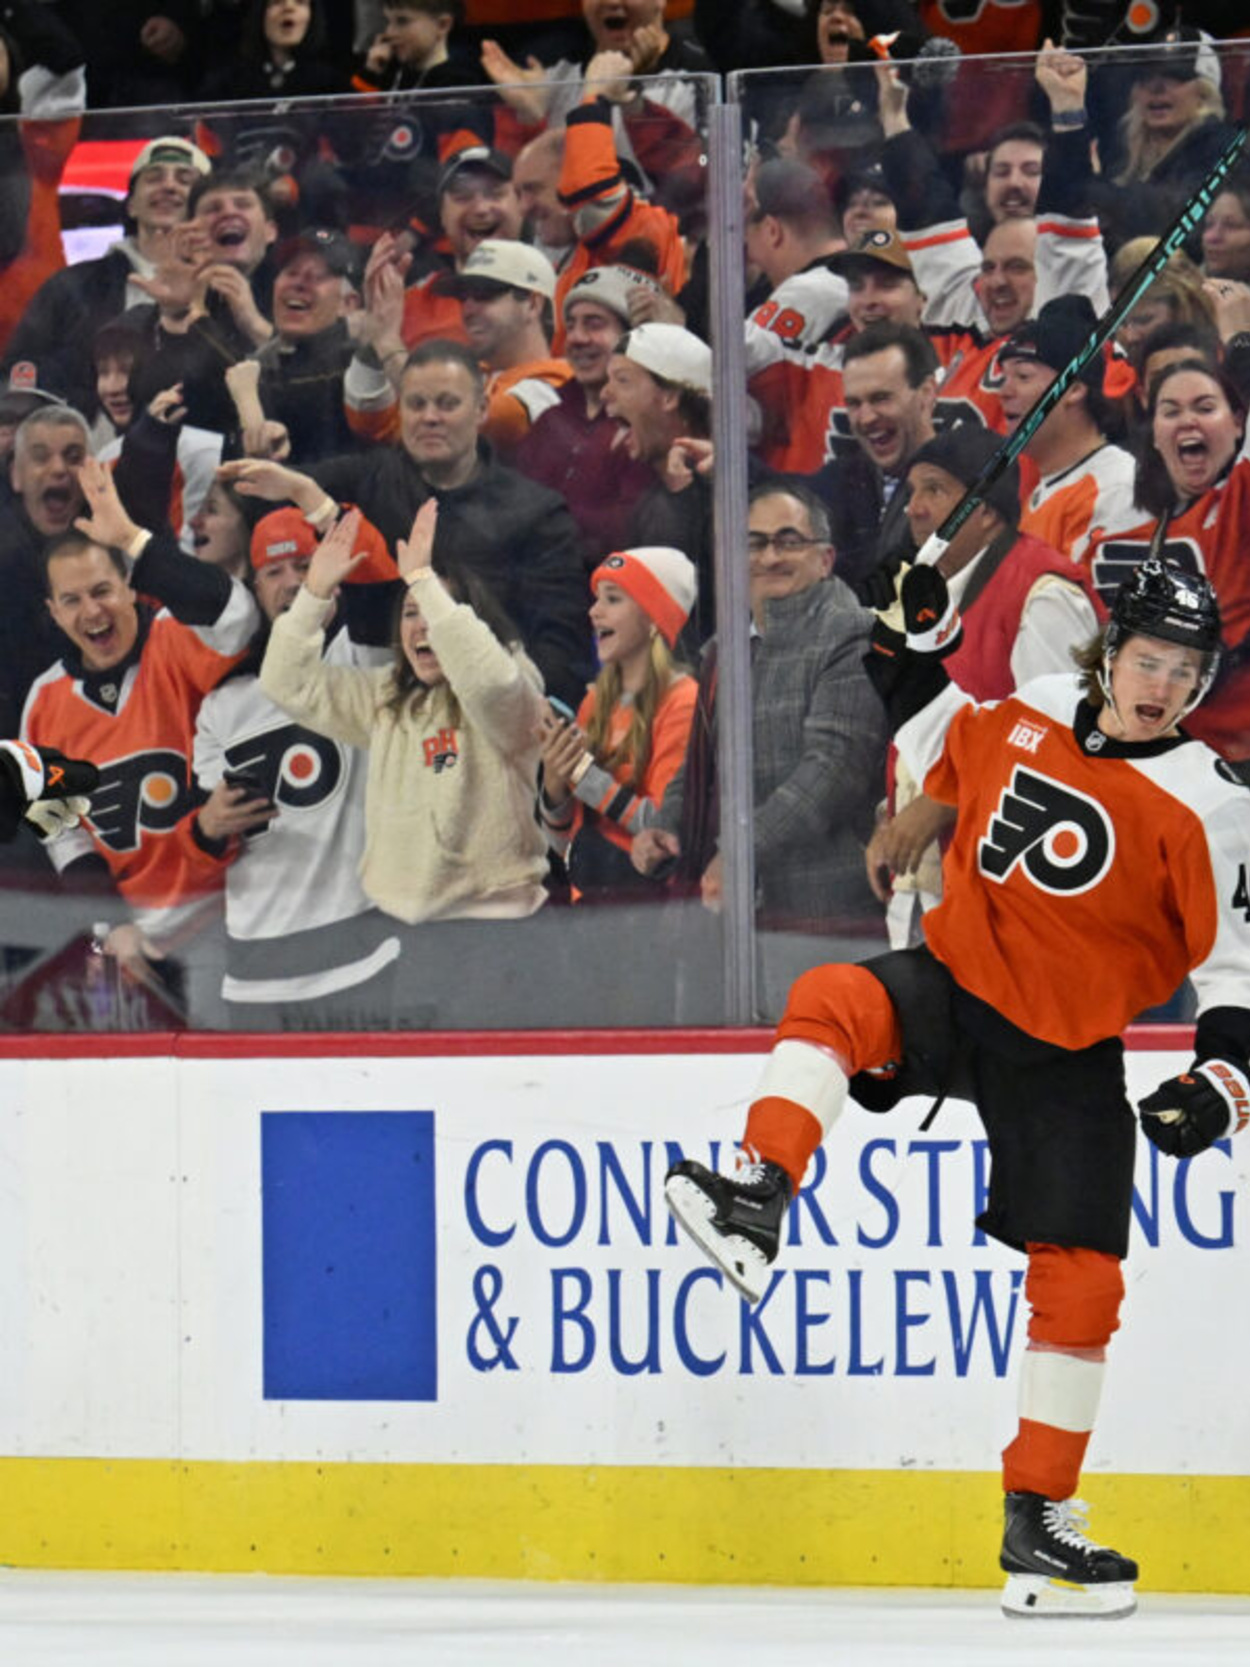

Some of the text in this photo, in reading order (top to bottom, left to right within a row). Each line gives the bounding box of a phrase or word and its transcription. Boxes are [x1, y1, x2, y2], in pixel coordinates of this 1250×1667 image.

[1174, 588, 1200, 610] 46
[1007, 723, 1049, 755] IBX
[1207, 1065, 1250, 1134] BAU
[464, 1139, 839, 1249] CONR
[467, 1265, 1026, 1379] & BUCKELEW
